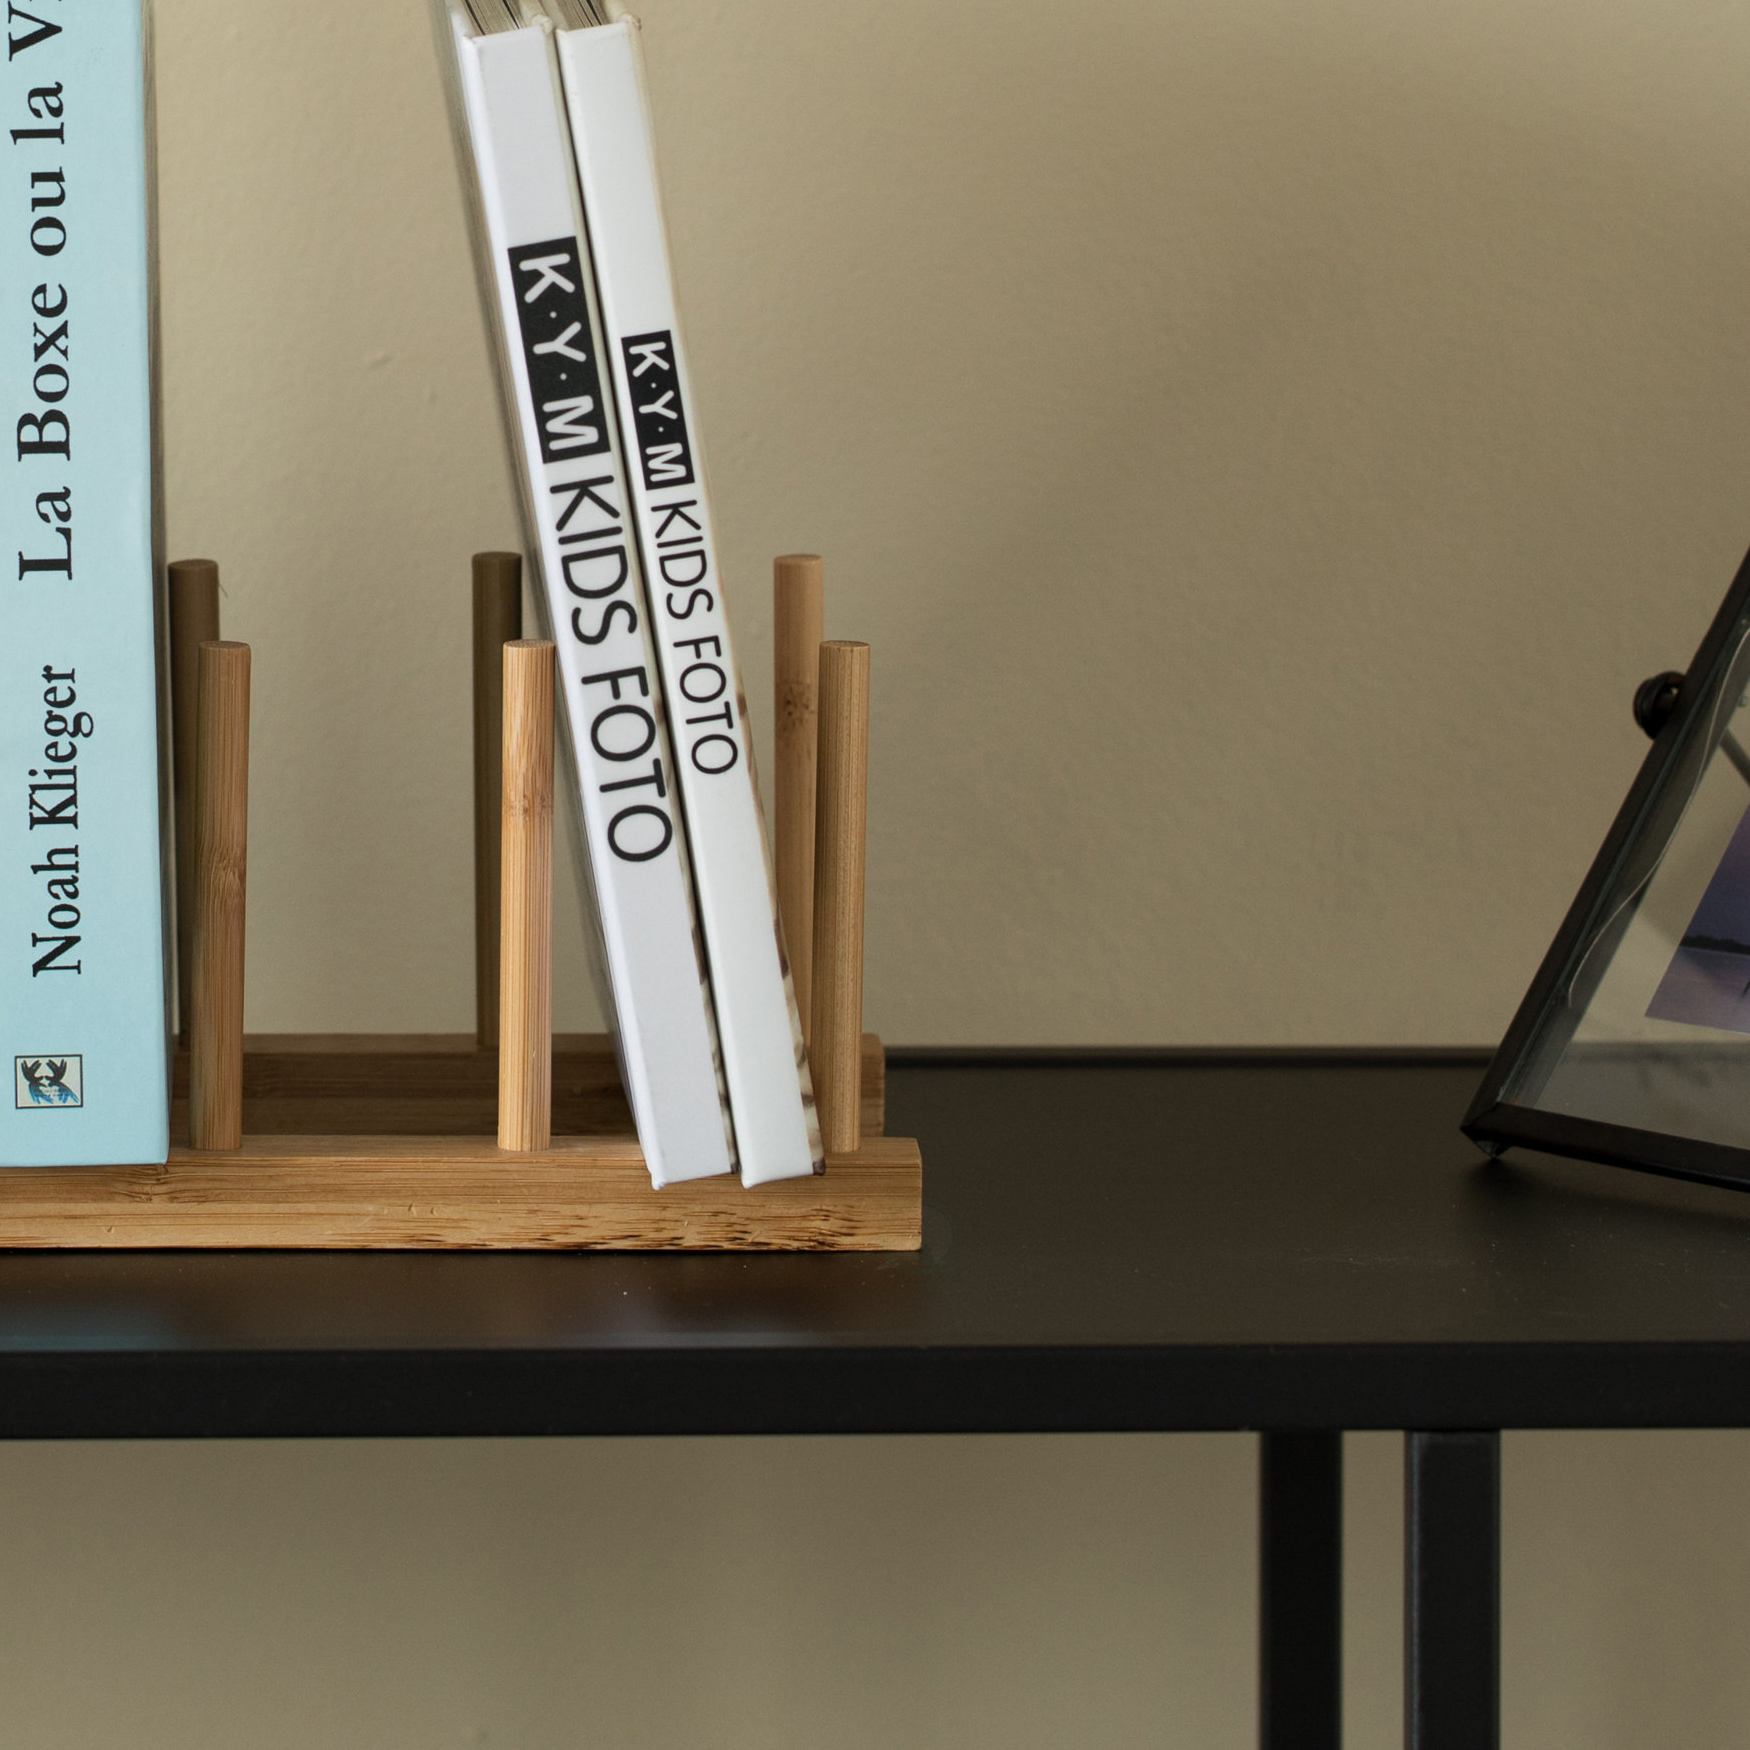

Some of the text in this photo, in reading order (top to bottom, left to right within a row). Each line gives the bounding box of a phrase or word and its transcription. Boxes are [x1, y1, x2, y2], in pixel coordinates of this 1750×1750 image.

[9, 81, 65, 146] la
[30, 166, 67, 257] ou
[16, 283, 71, 463] Boxe
[17, 485, 73, 581] La
[549, 475, 638, 646] KIDS
[650, 499, 714, 620] KIDS
[581, 665, 673, 863] FOTO
[672, 635, 739, 775] FOTO
[28, 664, 94, 978] Noah Klieger
